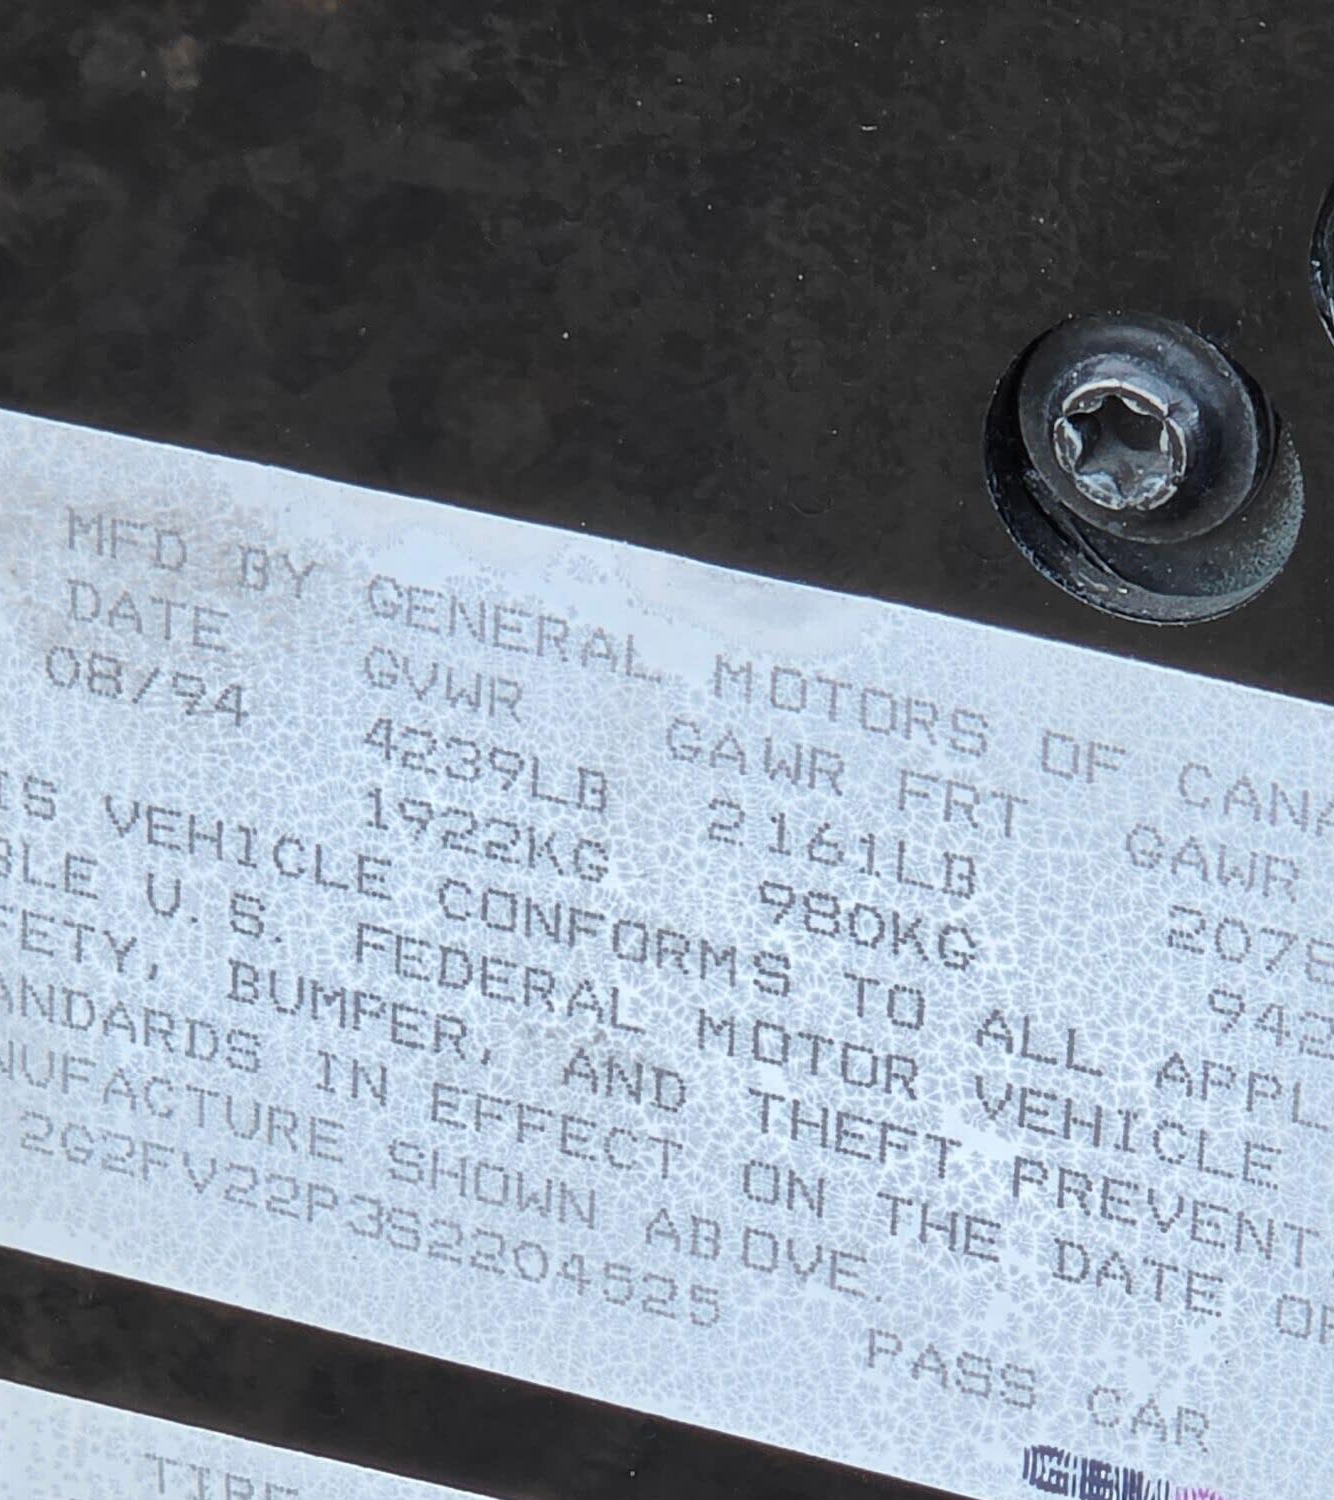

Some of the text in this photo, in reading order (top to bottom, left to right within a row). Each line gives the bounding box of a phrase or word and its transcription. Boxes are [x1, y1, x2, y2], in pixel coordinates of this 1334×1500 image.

[44, 638, 249, 732] 08/94
[362, 713, 610, 817] 4239LB
[707, 794, 979, 903] 2161LB
[66, 504, 188, 578] MFD
[237, 542, 315, 606] BY
[366, 572, 663, 686] GENERAL
[713, 651, 991, 760] MOTORS
[1039, 727, 1126, 793] OF
[66, 576, 229, 656] DATE
[363, 644, 524, 725] GVWR
[666, 715, 846, 799] GAWR
[899, 768, 1027, 841] FRT
[1127, 822, 1303, 906] GAWR
[103, 791, 394, 905] VEHICLE
[438, 871, 793, 1002] CONFORMS
[841, 971, 928, 1034] TO
[975, 1004, 1105, 1078] ALL
[363, 785, 610, 889] 1922KG
[757, 878, 977, 976] 980KG
[145, 871, 286, 947] U.S.
[355, 921, 647, 1036] FEDERAL
[697, 1006, 920, 1103] MOTOR
[973, 1073, 1283, 1193] VEHICLE
[226, 958, 494, 1069] BUMPER,
[561, 1042, 688, 1117] AND
[745, 1087, 964, 1185] THEFT
[20, 1107, 1212, 1455] 2G2FV22P3S2204525 PASS CAR
[315, 1049, 390, 1109] IN
[430, 1080, 683, 1185] EFFECT
[741, 1156, 827, 1220] ON
[875, 1190, 1002, 1264] THE
[1051, 1235, 1225, 1321] DATE
[387, 1136, 597, 1232] SHOWN
[644, 1201, 885, 1306] ABOVE.
